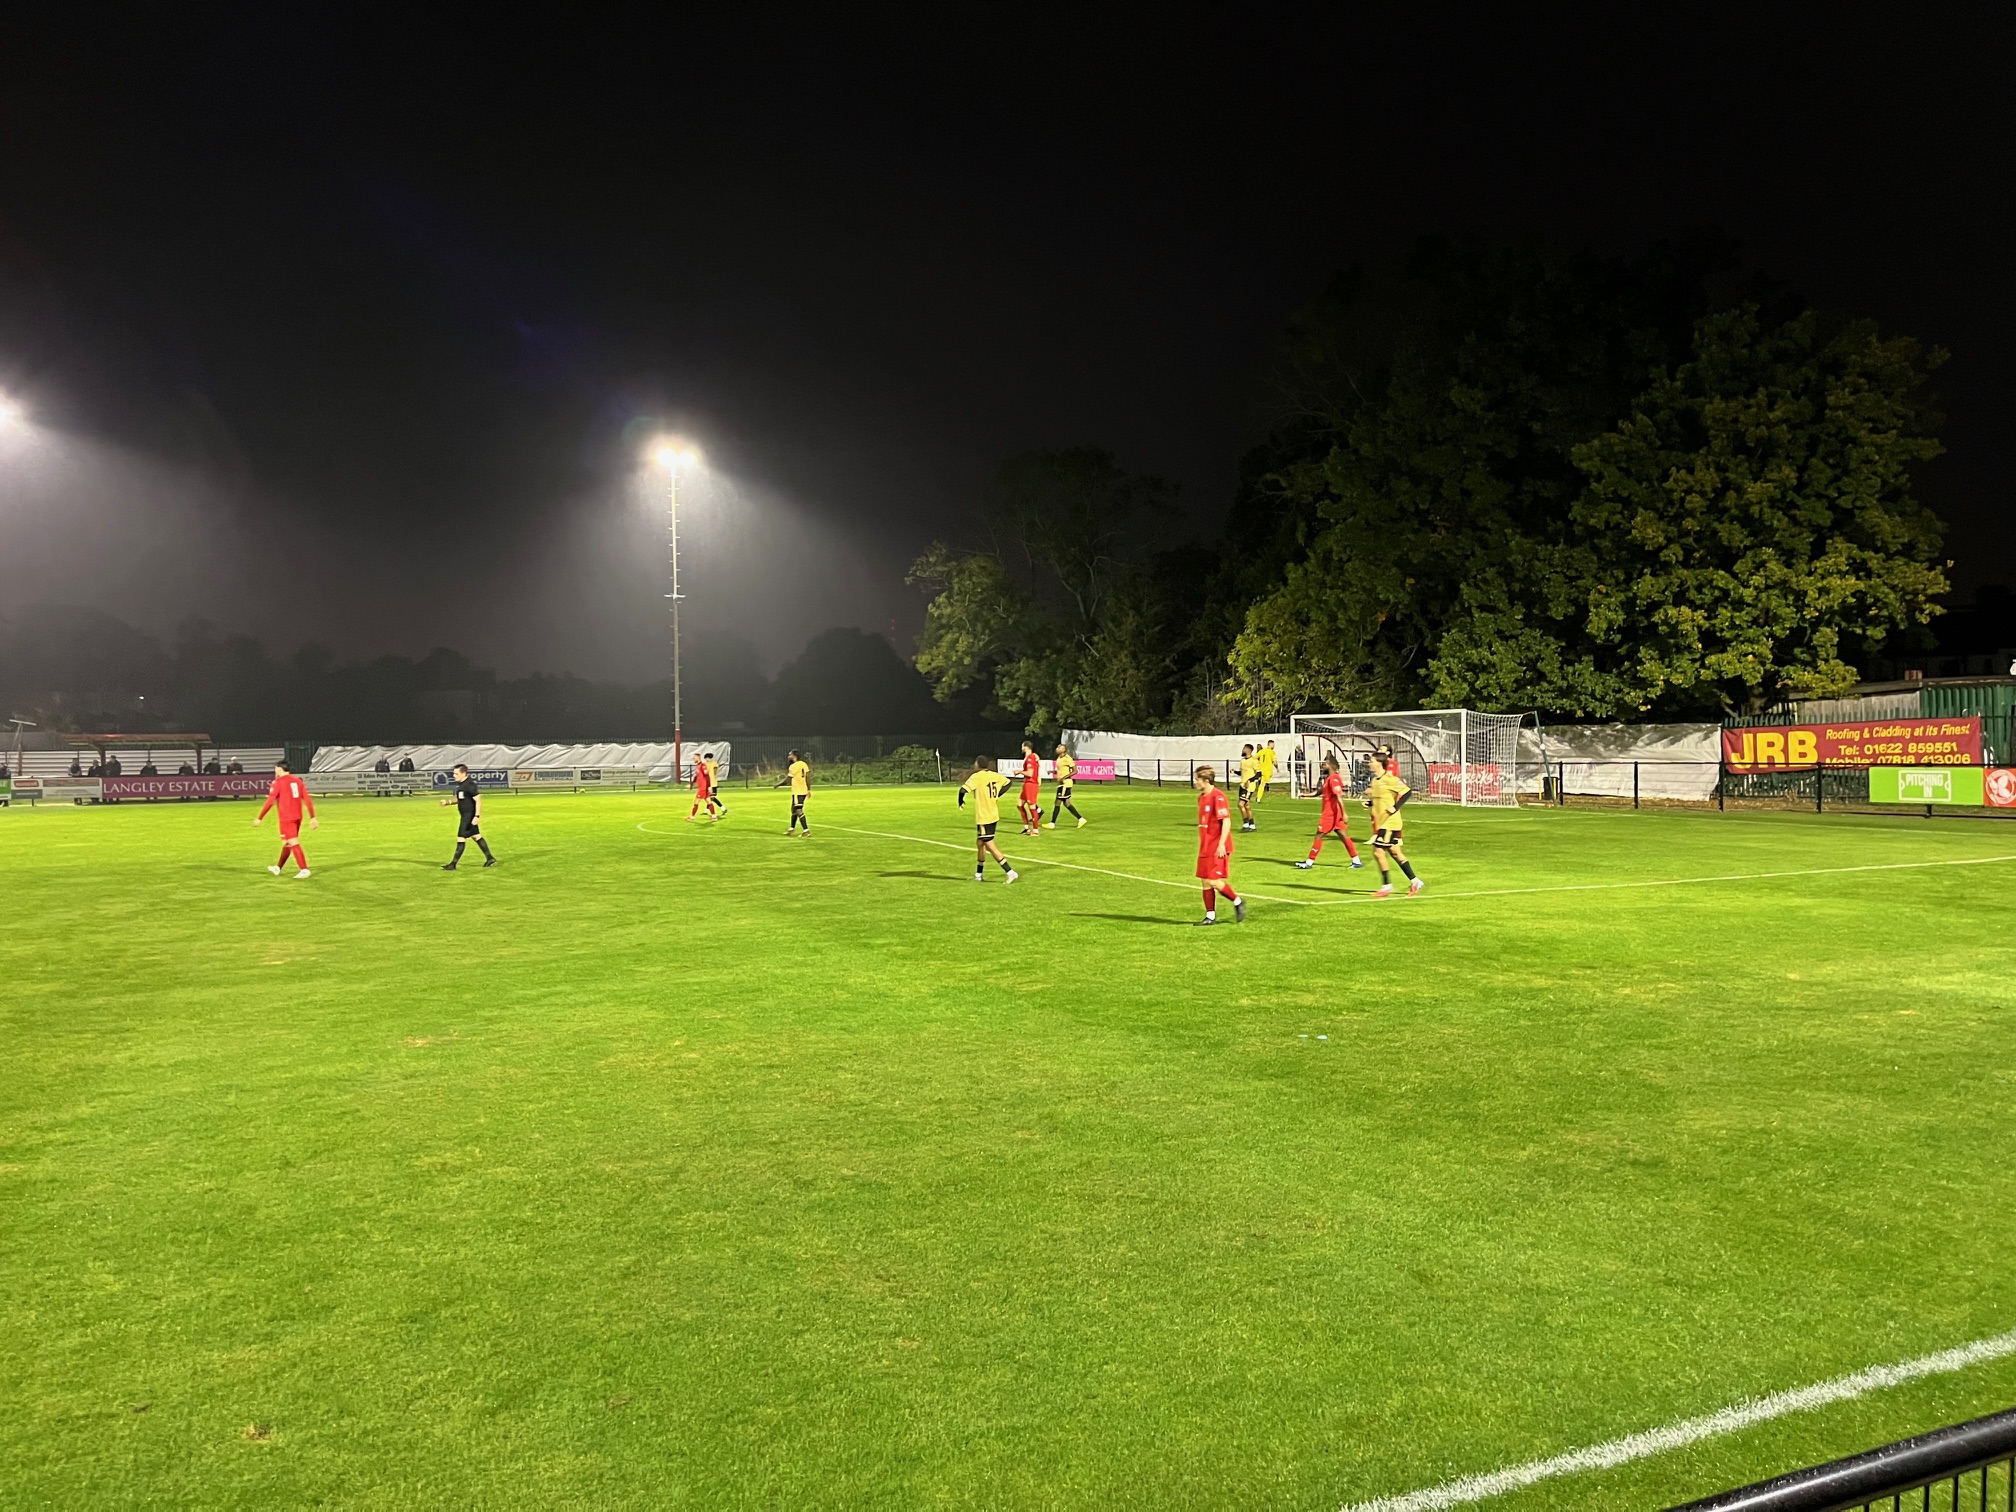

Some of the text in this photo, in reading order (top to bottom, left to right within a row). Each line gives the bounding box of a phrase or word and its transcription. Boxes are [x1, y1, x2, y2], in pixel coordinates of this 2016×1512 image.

[1826, 723, 1971, 741] Roofing & Cladding at its Finest
[1731, 731, 1818, 768] JRB
[1838, 742, 1957, 756] Tel: 01622 859551
[1921, 754, 1971, 764] 413006
[468, 770, 506, 780] roperty
[1077, 766, 1114, 775] STATE AGENTS
[1433, 772, 1444, 783] UP
[1447, 772, 1462, 784] THE
[1905, 773, 1944, 786] PITCHING
[103, 782, 165, 794] LANGLEY
[169, 780, 215, 792] ESTATE
[221, 779, 272, 790] AGENTS
[986, 781, 998, 798] 15
